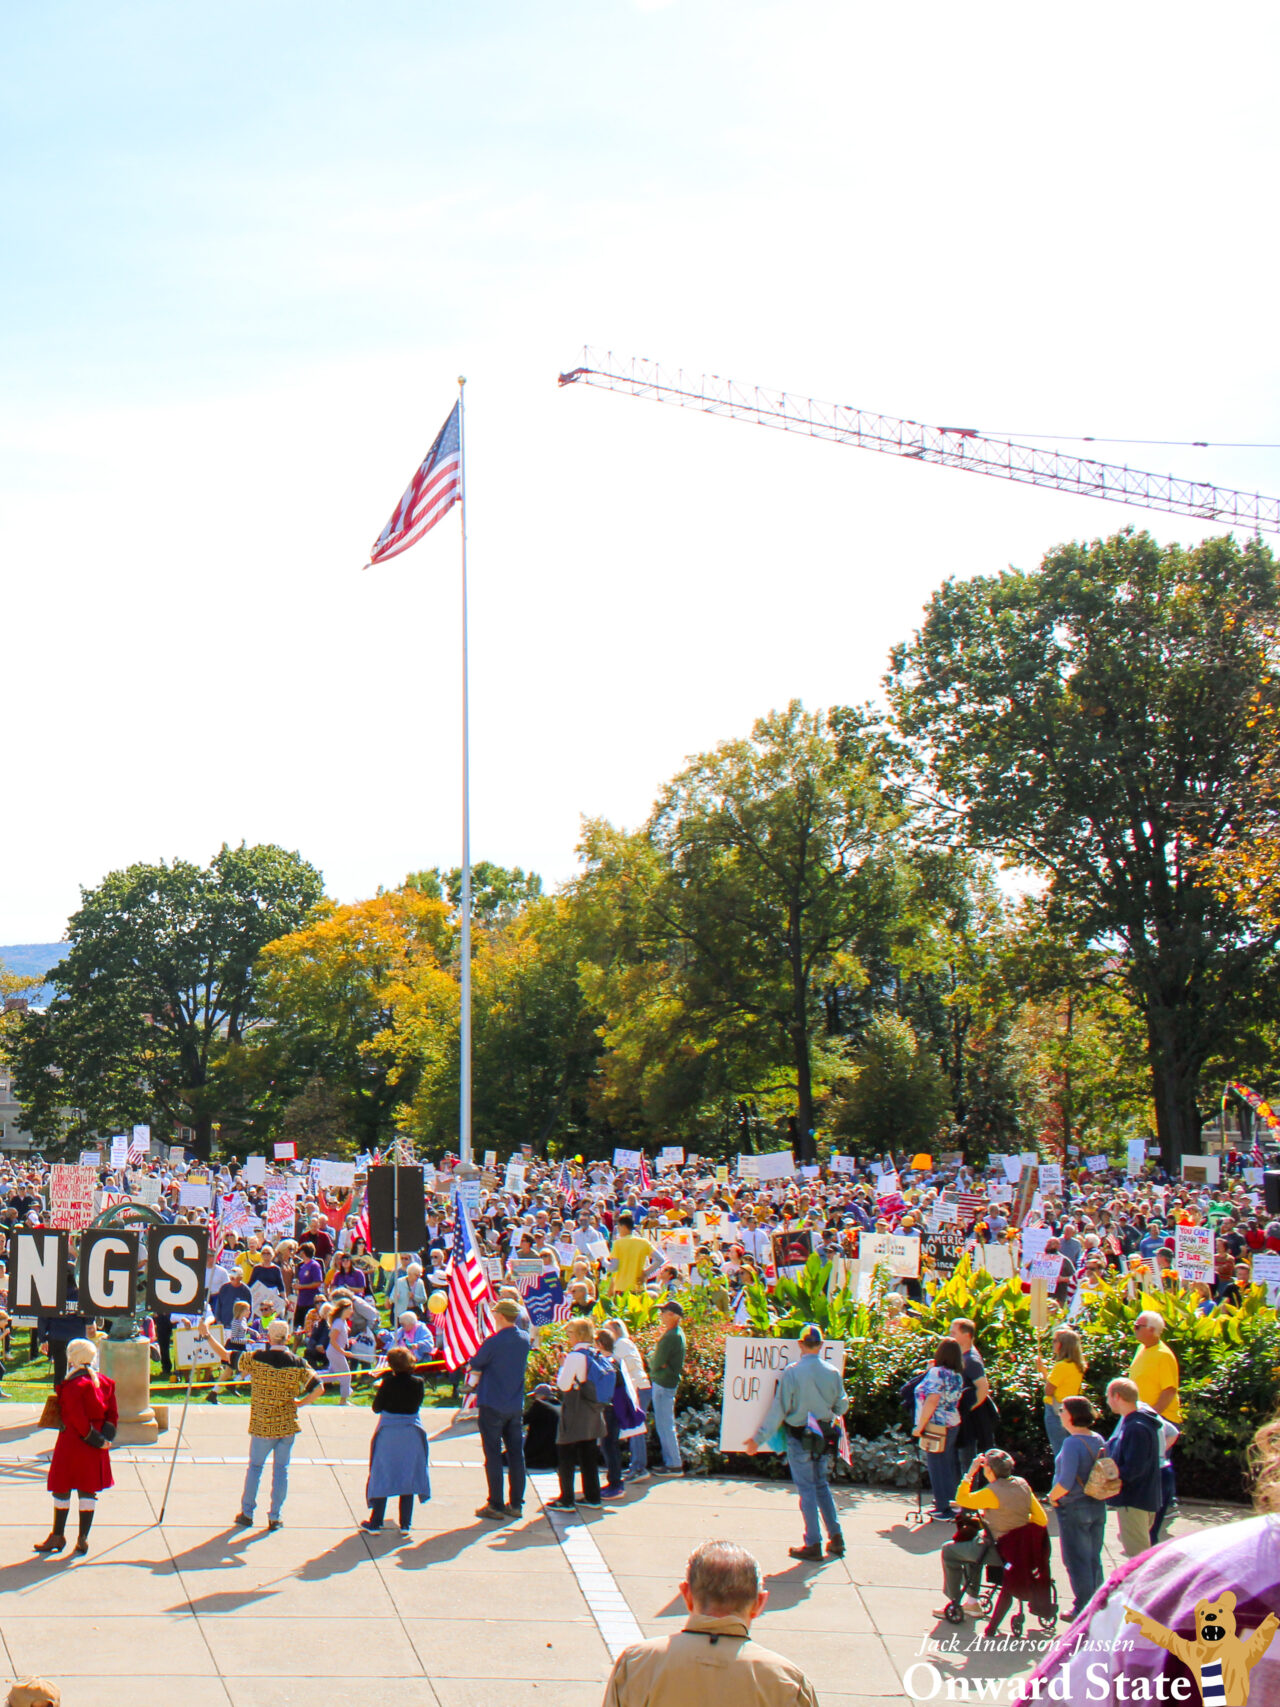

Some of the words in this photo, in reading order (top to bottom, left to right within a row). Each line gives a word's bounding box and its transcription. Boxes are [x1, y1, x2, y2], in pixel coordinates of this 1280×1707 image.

[928, 1235, 965, 1247] AMERIC
[1198, 1236, 1209, 1244] THE
[921, 1243, 937, 1255] NO
[1184, 1269, 1193, 1278] IN
[744, 1344, 789, 1371] HANDS
[732, 1375, 761, 1402] OUR
